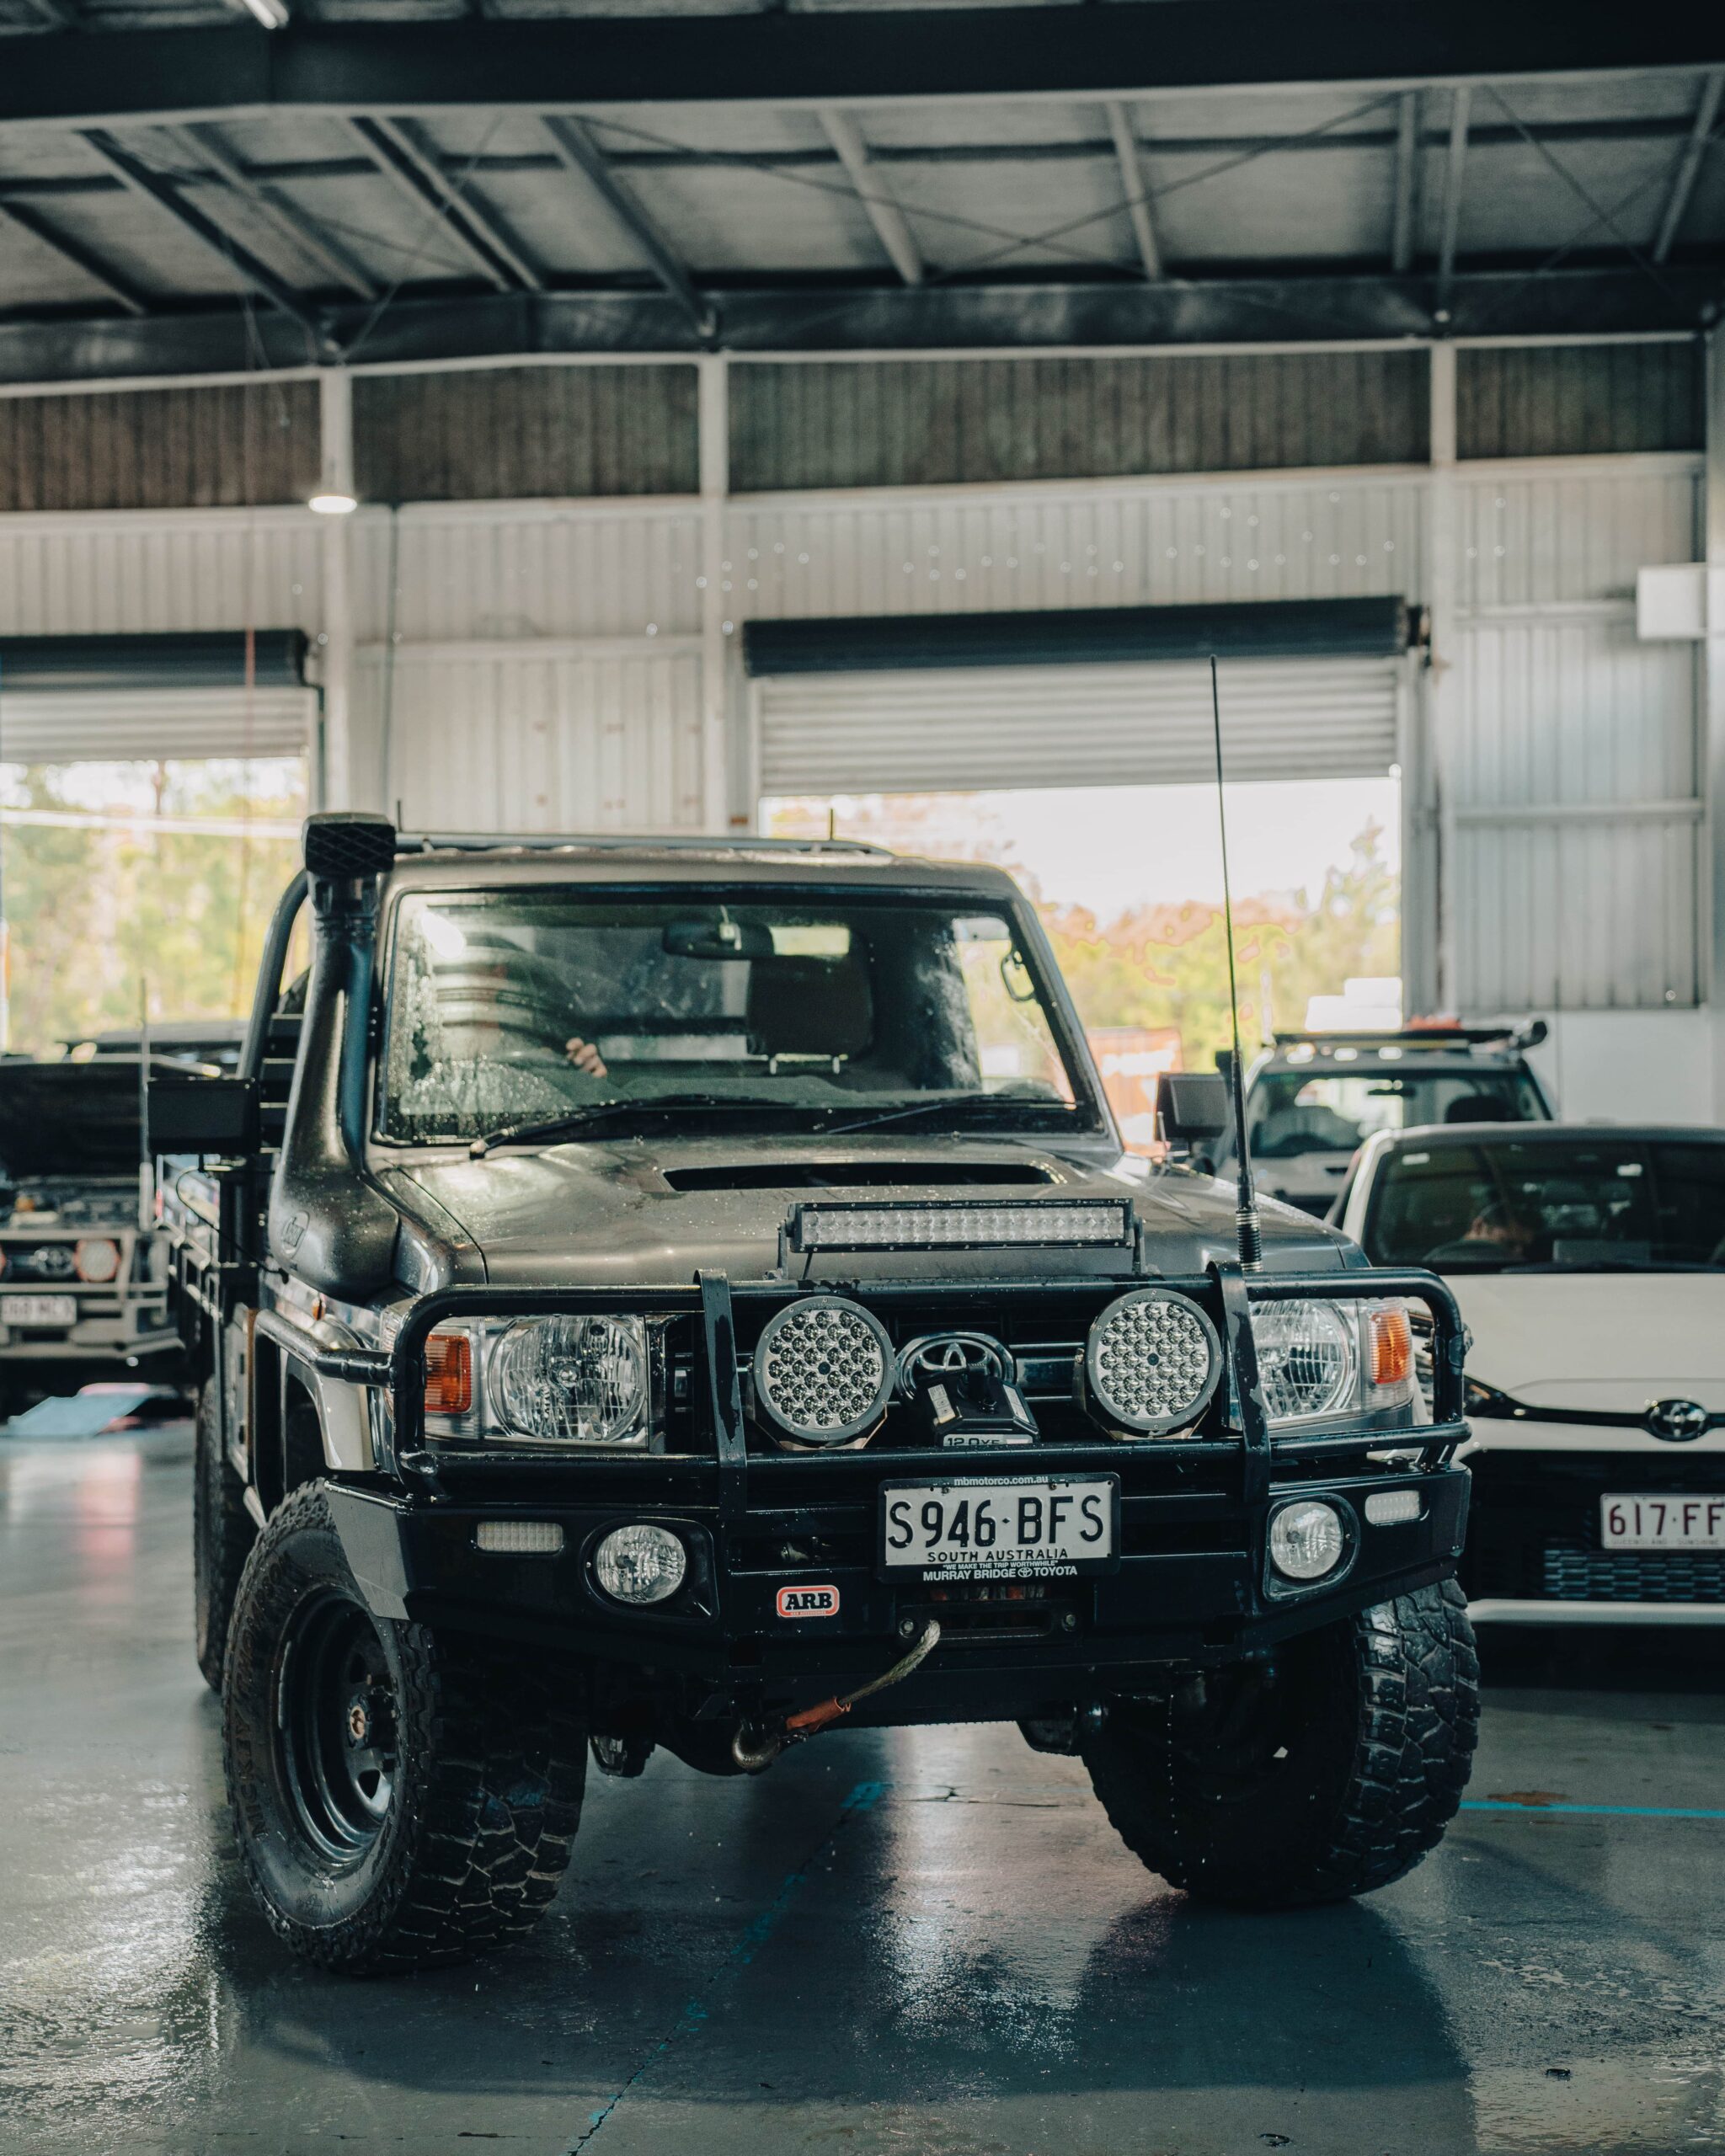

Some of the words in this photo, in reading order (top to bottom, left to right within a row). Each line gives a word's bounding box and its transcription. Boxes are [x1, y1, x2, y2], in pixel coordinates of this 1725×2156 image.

[953, 1476, 1049, 1486] mbmotorco.com.au
[927, 1551, 978, 1563] SOUTH
[985, 1548, 1069, 1561] AUSTRALIA
[923, 1570, 971, 1581] MURRAY
[974, 1568, 1017, 1579] BRIDGE
[1033, 1566, 1078, 1577] TOYOTA
[785, 1592, 833, 1610] ARB
[234, 1708, 268, 1840] MICKEY
